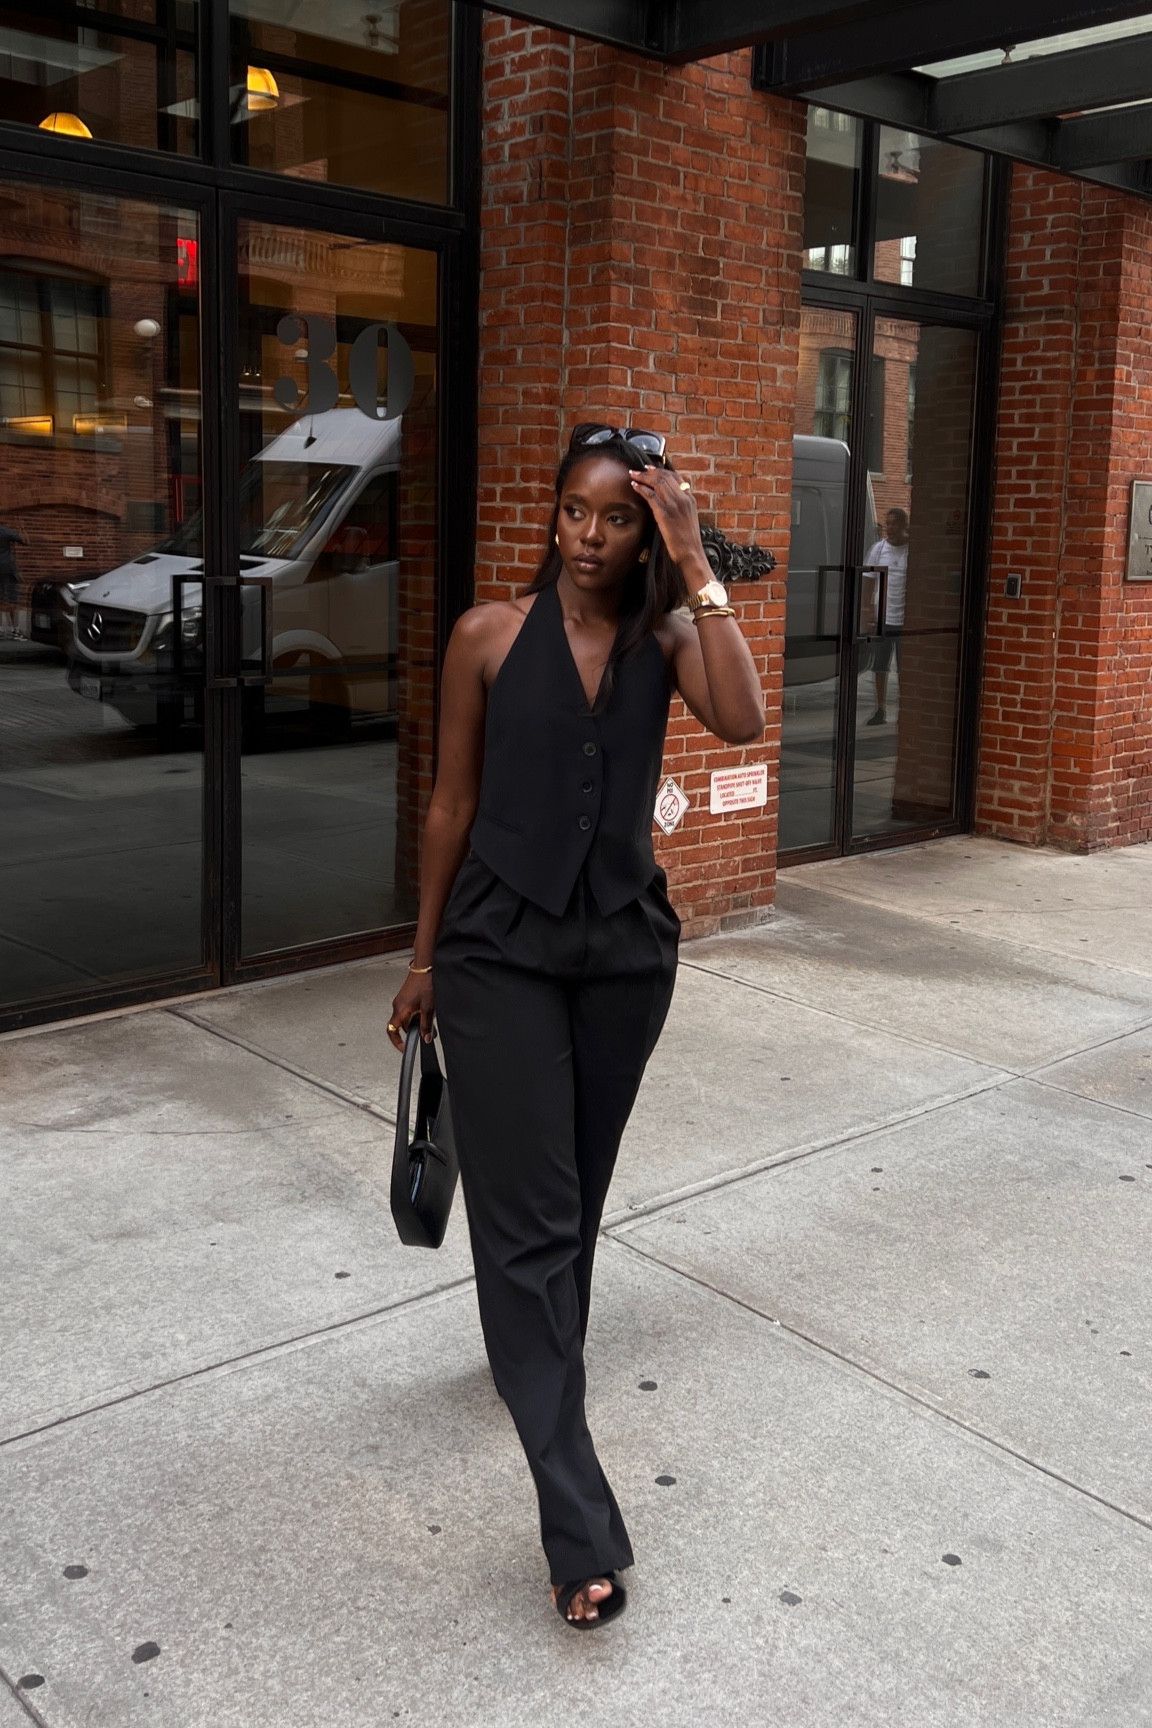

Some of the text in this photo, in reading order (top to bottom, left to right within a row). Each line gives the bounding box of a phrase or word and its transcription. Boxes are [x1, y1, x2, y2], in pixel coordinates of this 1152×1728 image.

[274, 313, 415, 421] 30
[714, 774, 737, 782] COMBINATION
[717, 782, 735, 791] STANDPIPE
